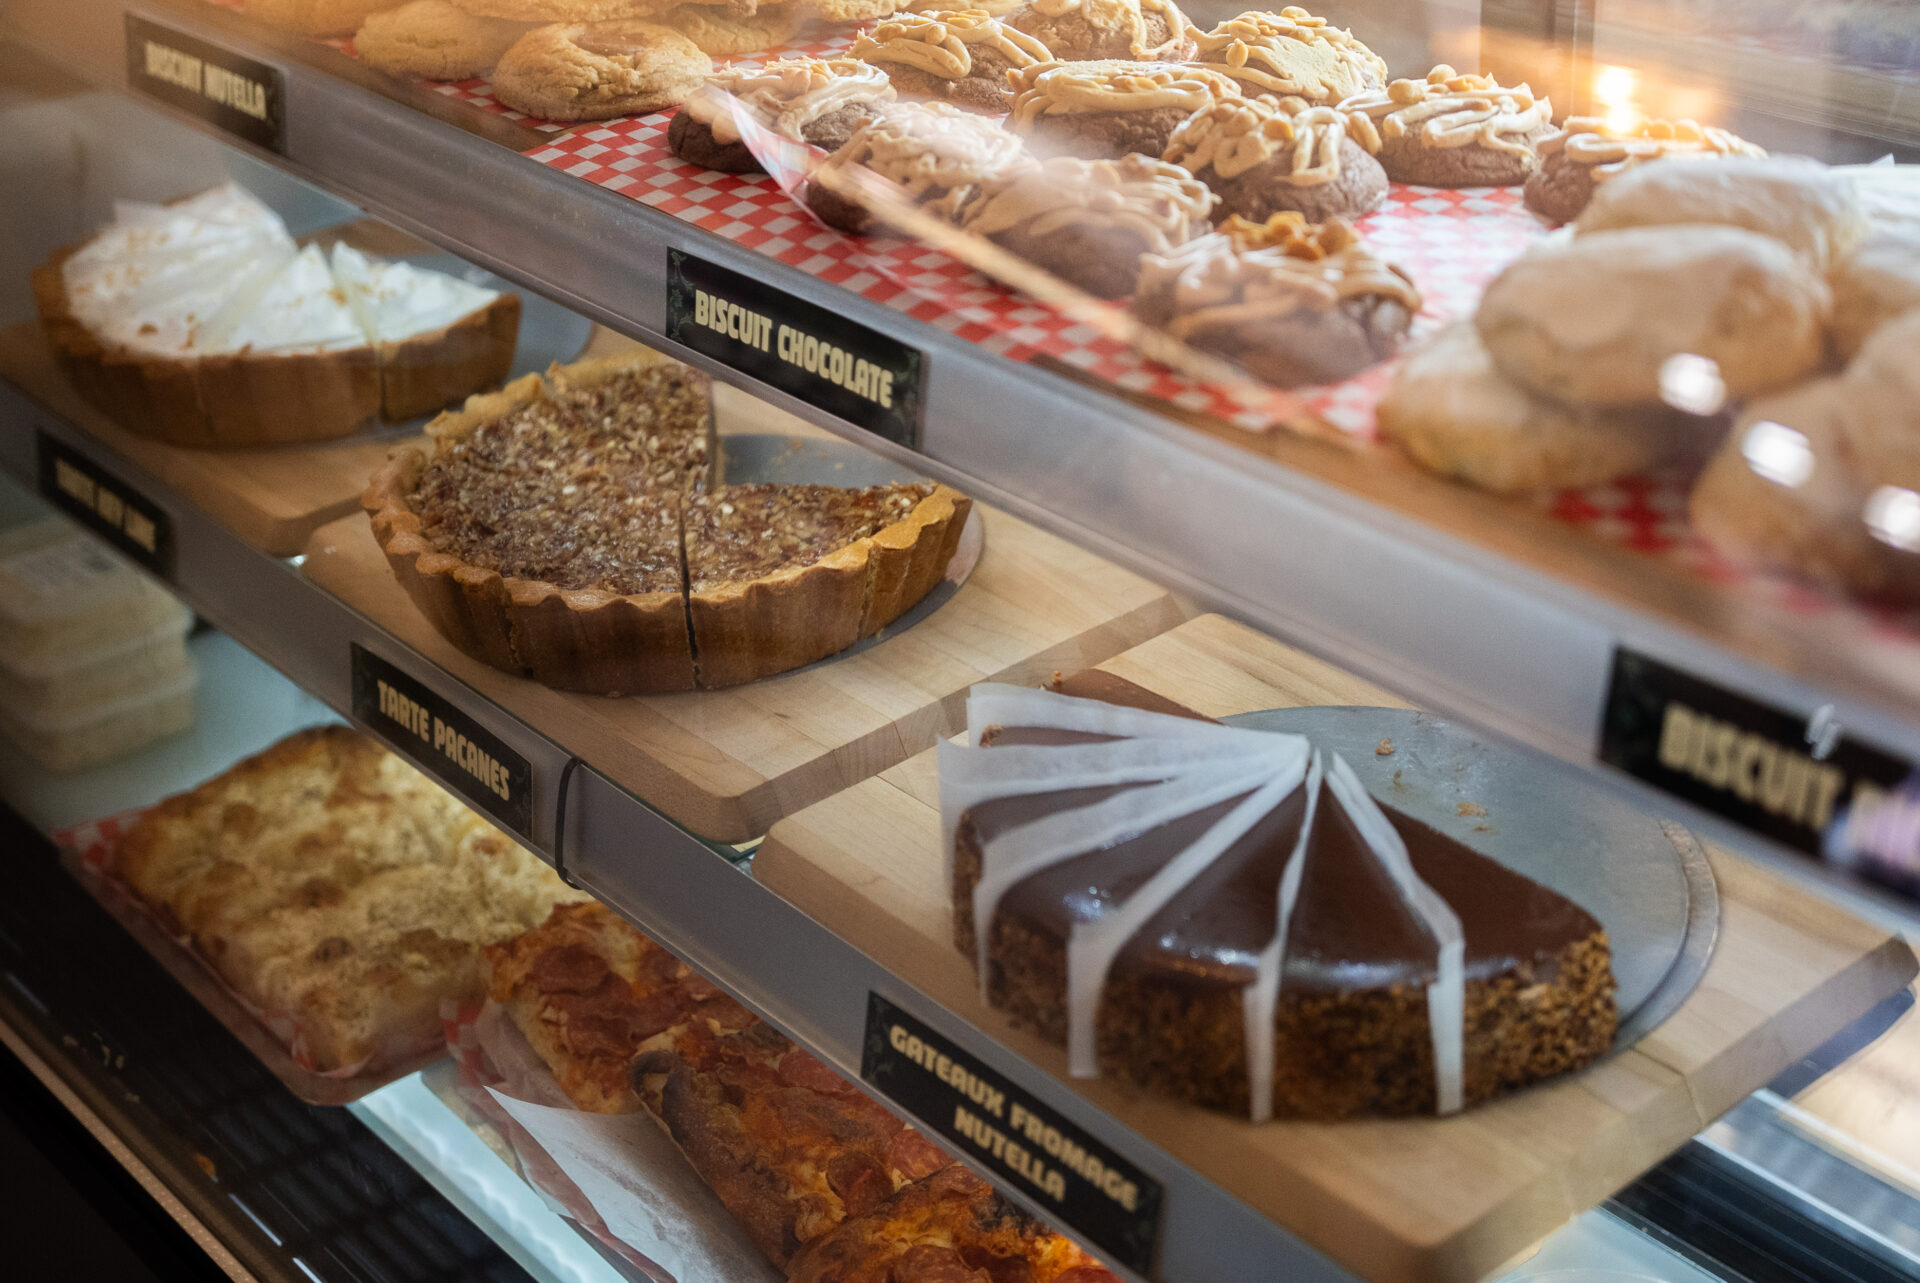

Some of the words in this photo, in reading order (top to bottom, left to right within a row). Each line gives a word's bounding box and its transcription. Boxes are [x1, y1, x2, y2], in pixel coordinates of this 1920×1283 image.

[204, 62, 267, 120] NUTELLA
[695, 289, 772, 352] BISCUIT
[777, 324, 894, 409] CHOCOLATE
[377, 679, 430, 743] TARTE
[433, 716, 510, 801] PACANES
[1658, 701, 1845, 831] BISCUIT
[889, 1024, 1006, 1118] GATEAUX
[1010, 1103, 1138, 1212] FROMAGE
[953, 1105, 1066, 1201] NUTELLA
